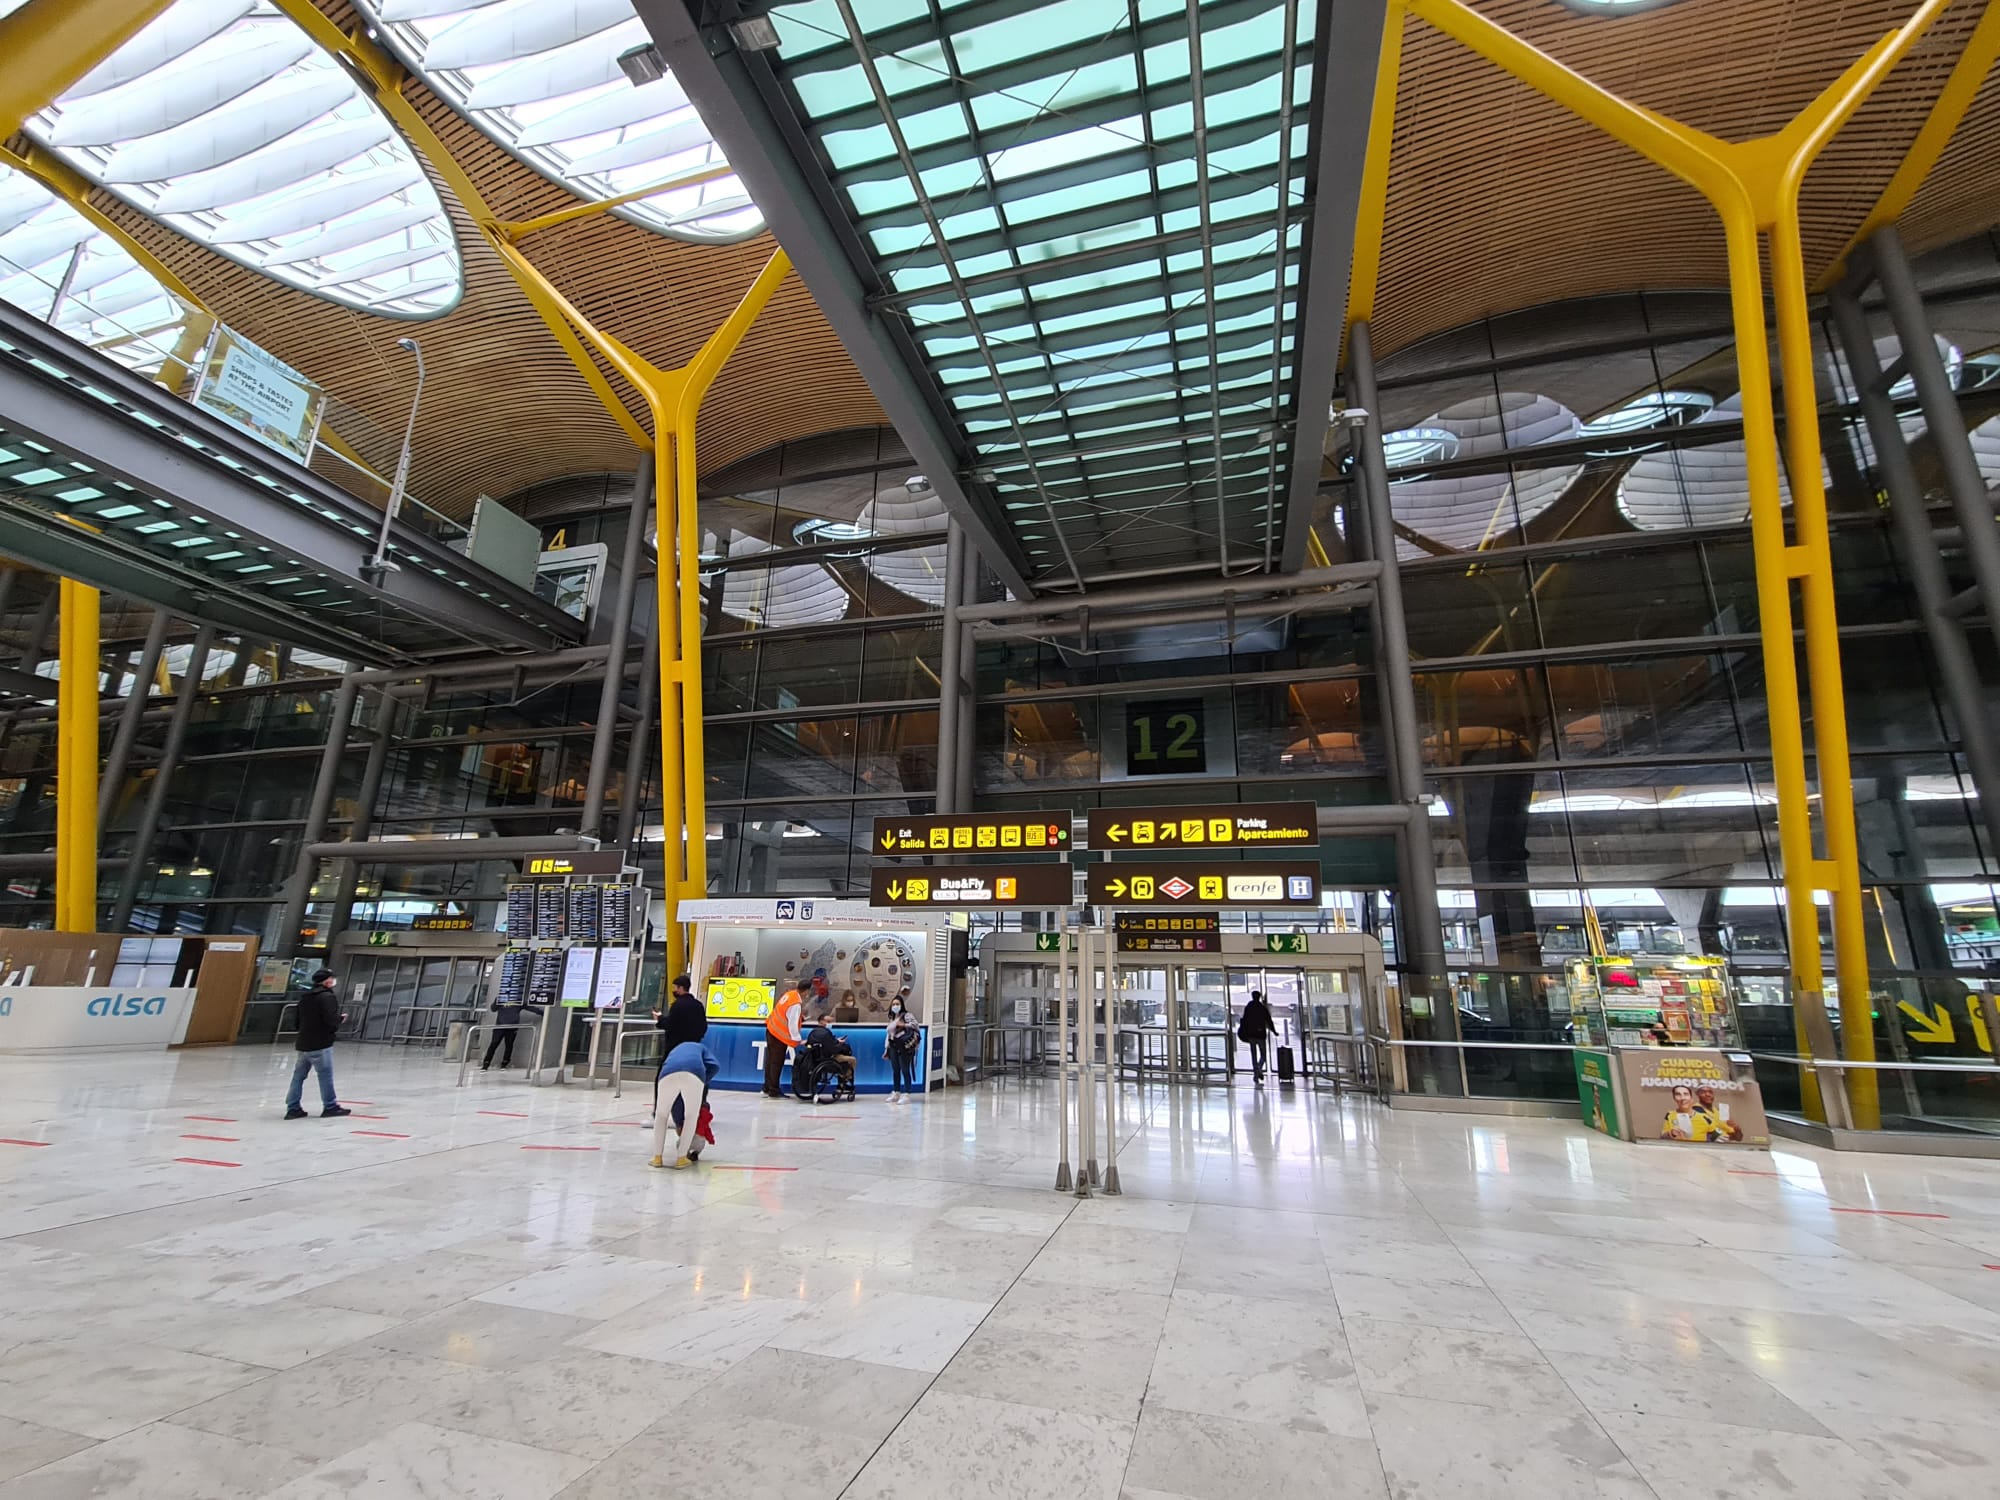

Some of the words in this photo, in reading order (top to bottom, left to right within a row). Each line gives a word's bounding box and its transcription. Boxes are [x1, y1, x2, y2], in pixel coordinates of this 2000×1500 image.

[231, 365, 257, 385] SHOPS
[267, 388, 294, 407] TASTES
[228, 373, 239, 381] AT
[241, 380, 256, 393] THE
[257, 390, 290, 412] AIRPORT
[548, 528, 566, 551] 4
[1132, 714, 1198, 761] 12
[1237, 818, 1267, 830] Parking
[899, 829, 912, 838] Exit
[1216, 824, 1226, 837] P
[1238, 828, 1308, 840] Aparcamiento
[900, 839, 926, 849] Salida
[940, 878, 984, 890] Bus&Fly
[1234, 880, 1276, 896] renfe
[87, 994, 167, 1016] alsa
[1660, 1058, 1714, 1069] CUANDO
[1656, 1068, 1702, 1078] JUEGAS
[1640, 1077, 1698, 1088] JUGAMOS
